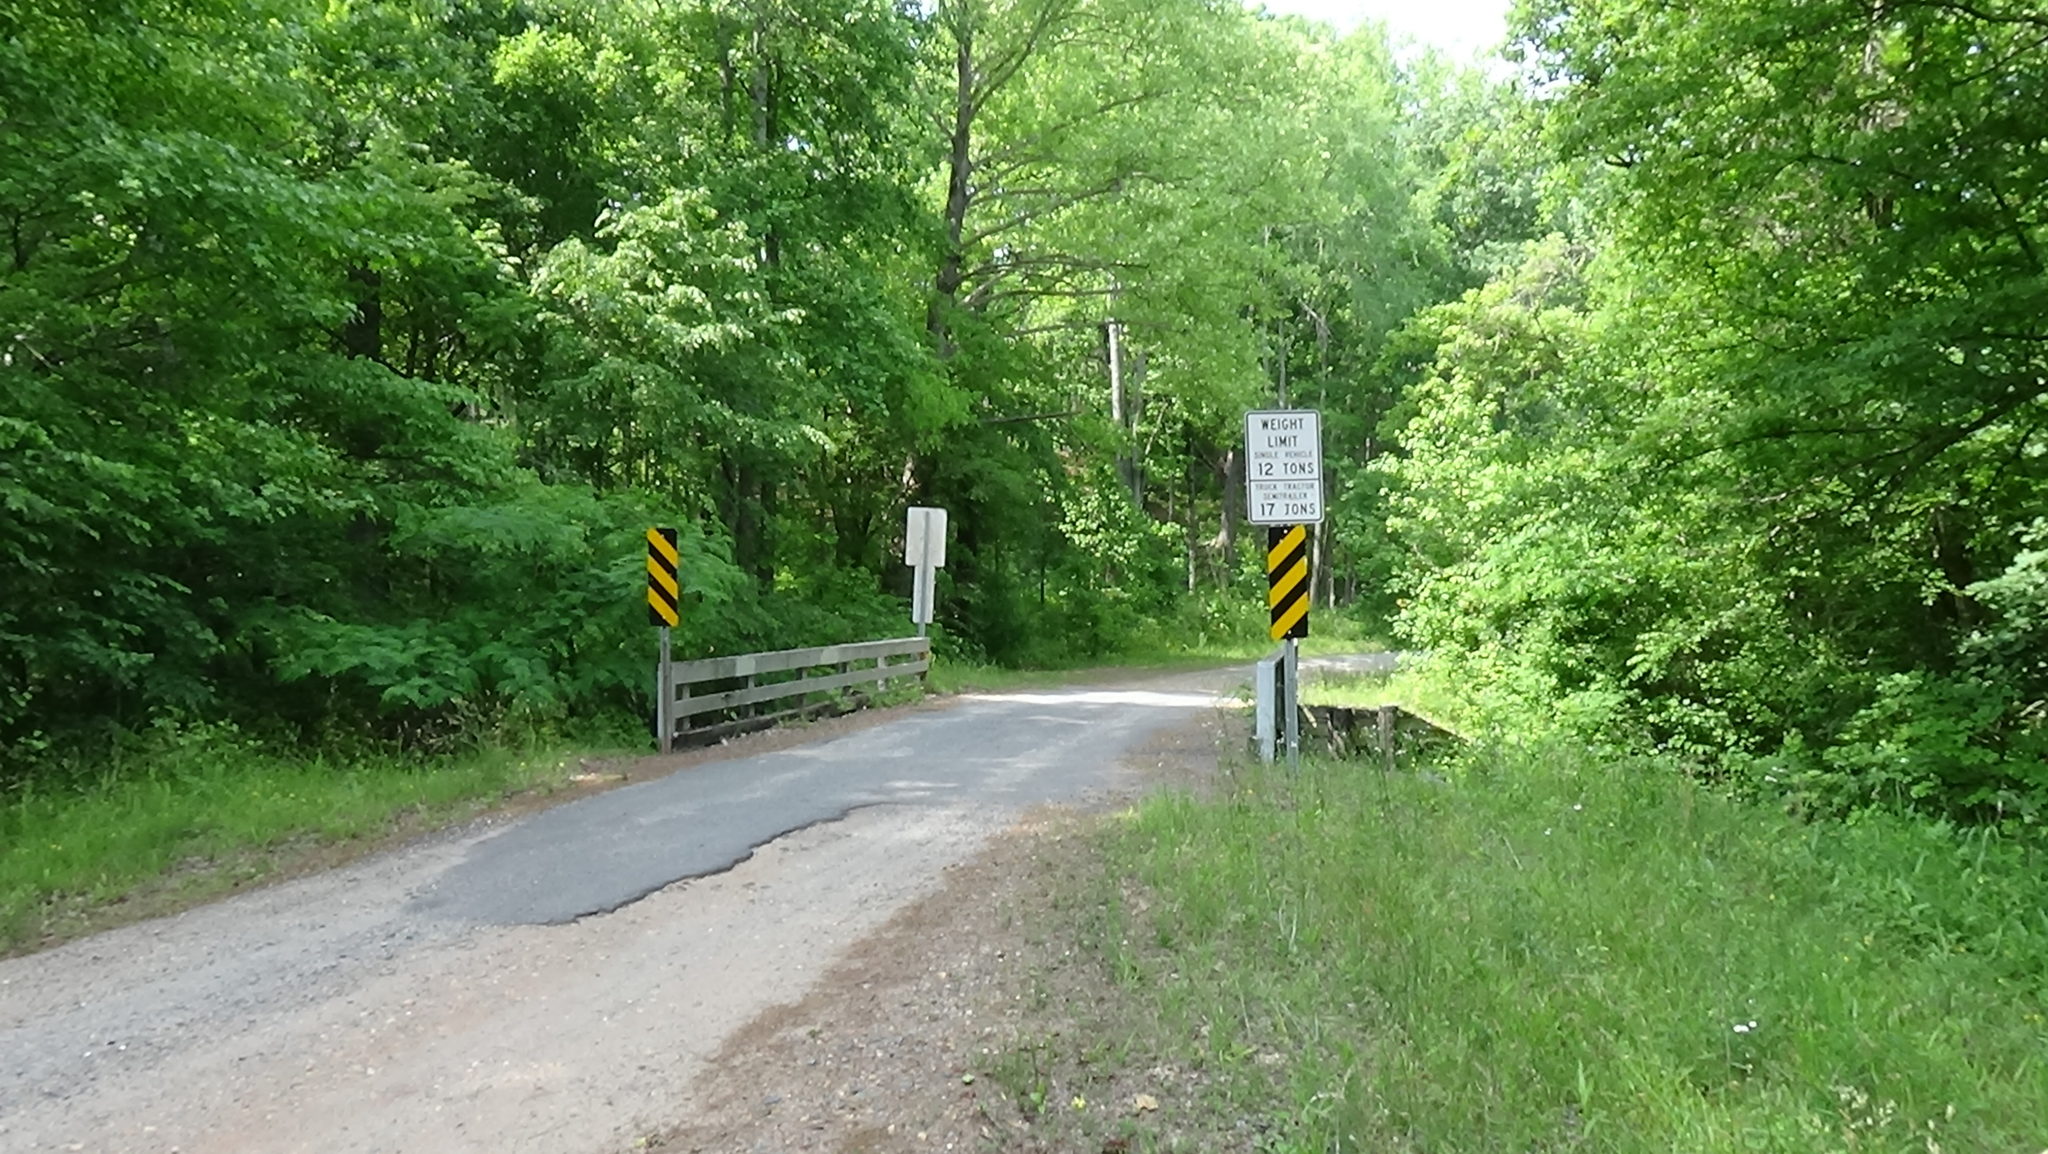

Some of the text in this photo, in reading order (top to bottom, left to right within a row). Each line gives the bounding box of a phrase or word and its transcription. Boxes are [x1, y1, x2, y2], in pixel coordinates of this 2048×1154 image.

[1261, 418, 1303, 430] WEIGHT
[1267, 435, 1297, 448] LIMIT
[1259, 462, 1314, 476] 12 TONS
[1261, 503, 1315, 516] 17 TONS
